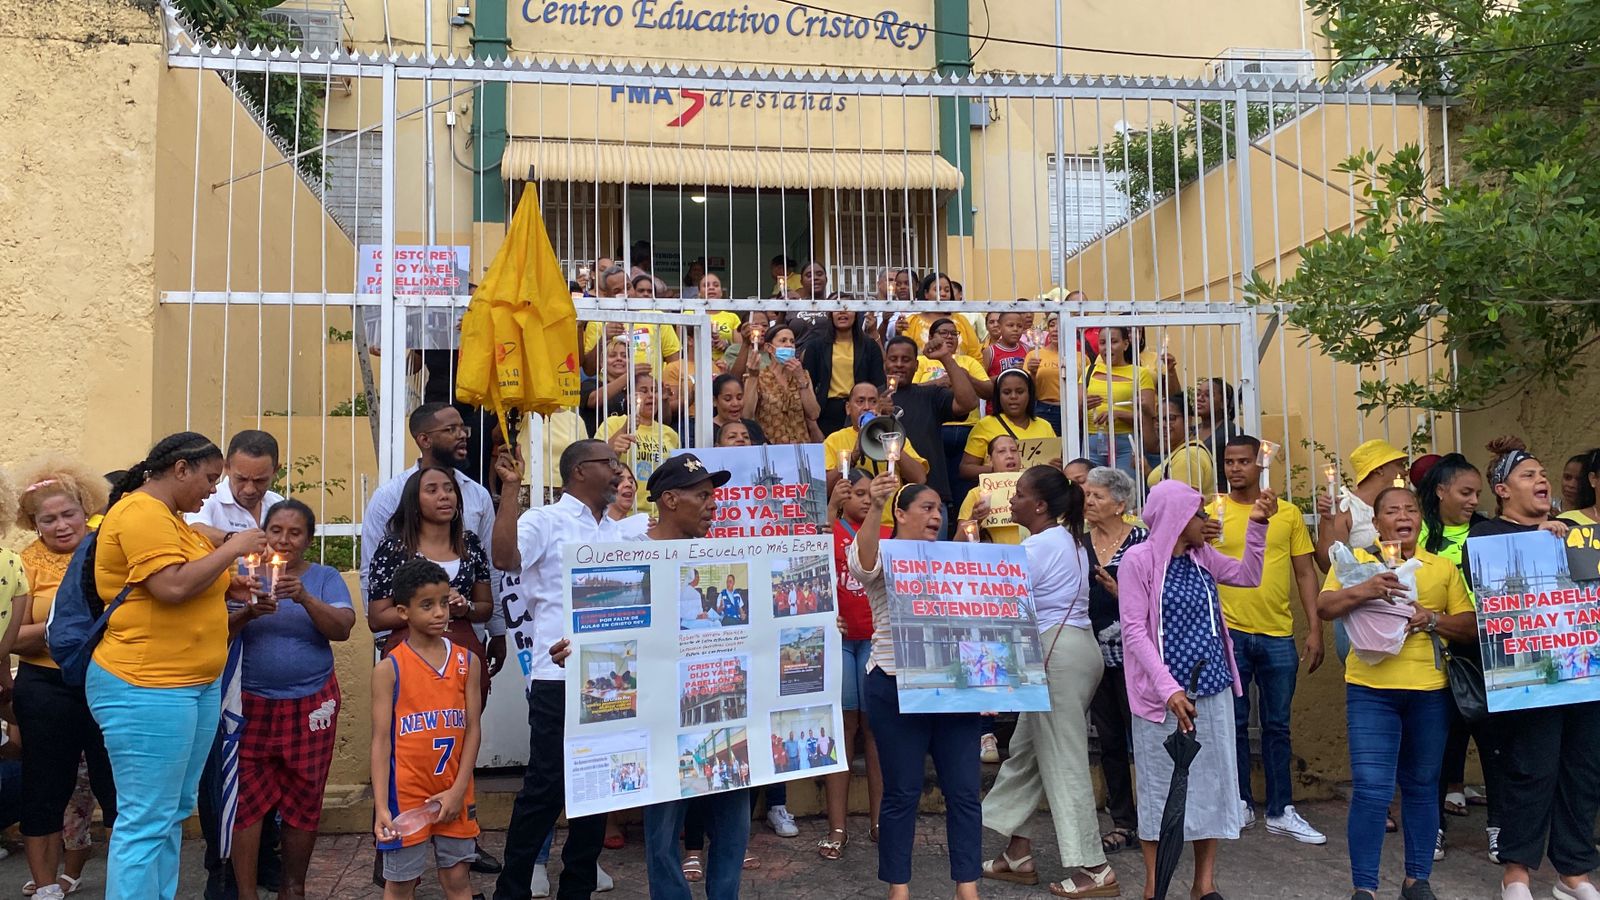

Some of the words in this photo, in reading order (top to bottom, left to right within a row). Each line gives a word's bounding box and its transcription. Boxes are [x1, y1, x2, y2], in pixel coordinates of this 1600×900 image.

[522, 0, 624, 27] Centro
[632, 0, 780, 35] Educativo
[786, 6, 869, 38] Cristo
[873, 10, 928, 50] Rey
[611, 86, 673, 104] FMA
[372, 251, 424, 260] ¡CISTO
[430, 251, 455, 260] REY
[375, 264, 406, 273] DO
[437, 265, 452, 273] EL
[443, 277, 460, 287] ES
[712, 485, 767, 501] RISTO
[772, 484, 808, 499] REY
[711, 506, 741, 522] IJO
[747, 506, 779, 521] YA,
[783, 505, 805, 518] EL
[704, 523, 788, 539] ABELLÓN
[794, 523, 817, 535] ES
[892, 560, 928, 574] ¡SIN
[932, 560, 1027, 580] PABELLÓN,
[895, 580, 923, 595] NO
[926, 581, 964, 596] HAY
[968, 582, 1028, 597] TANDA
[912, 600, 1019, 617] EXTENDIDA!
[1483, 594, 1520, 613] ¡SIN
[1486, 617, 1515, 635] NO
[1519, 613, 1559, 631] HAY
[400, 711, 440, 735] NEW
[441, 708, 468, 729] YOR
[433, 736, 456, 775] 7
